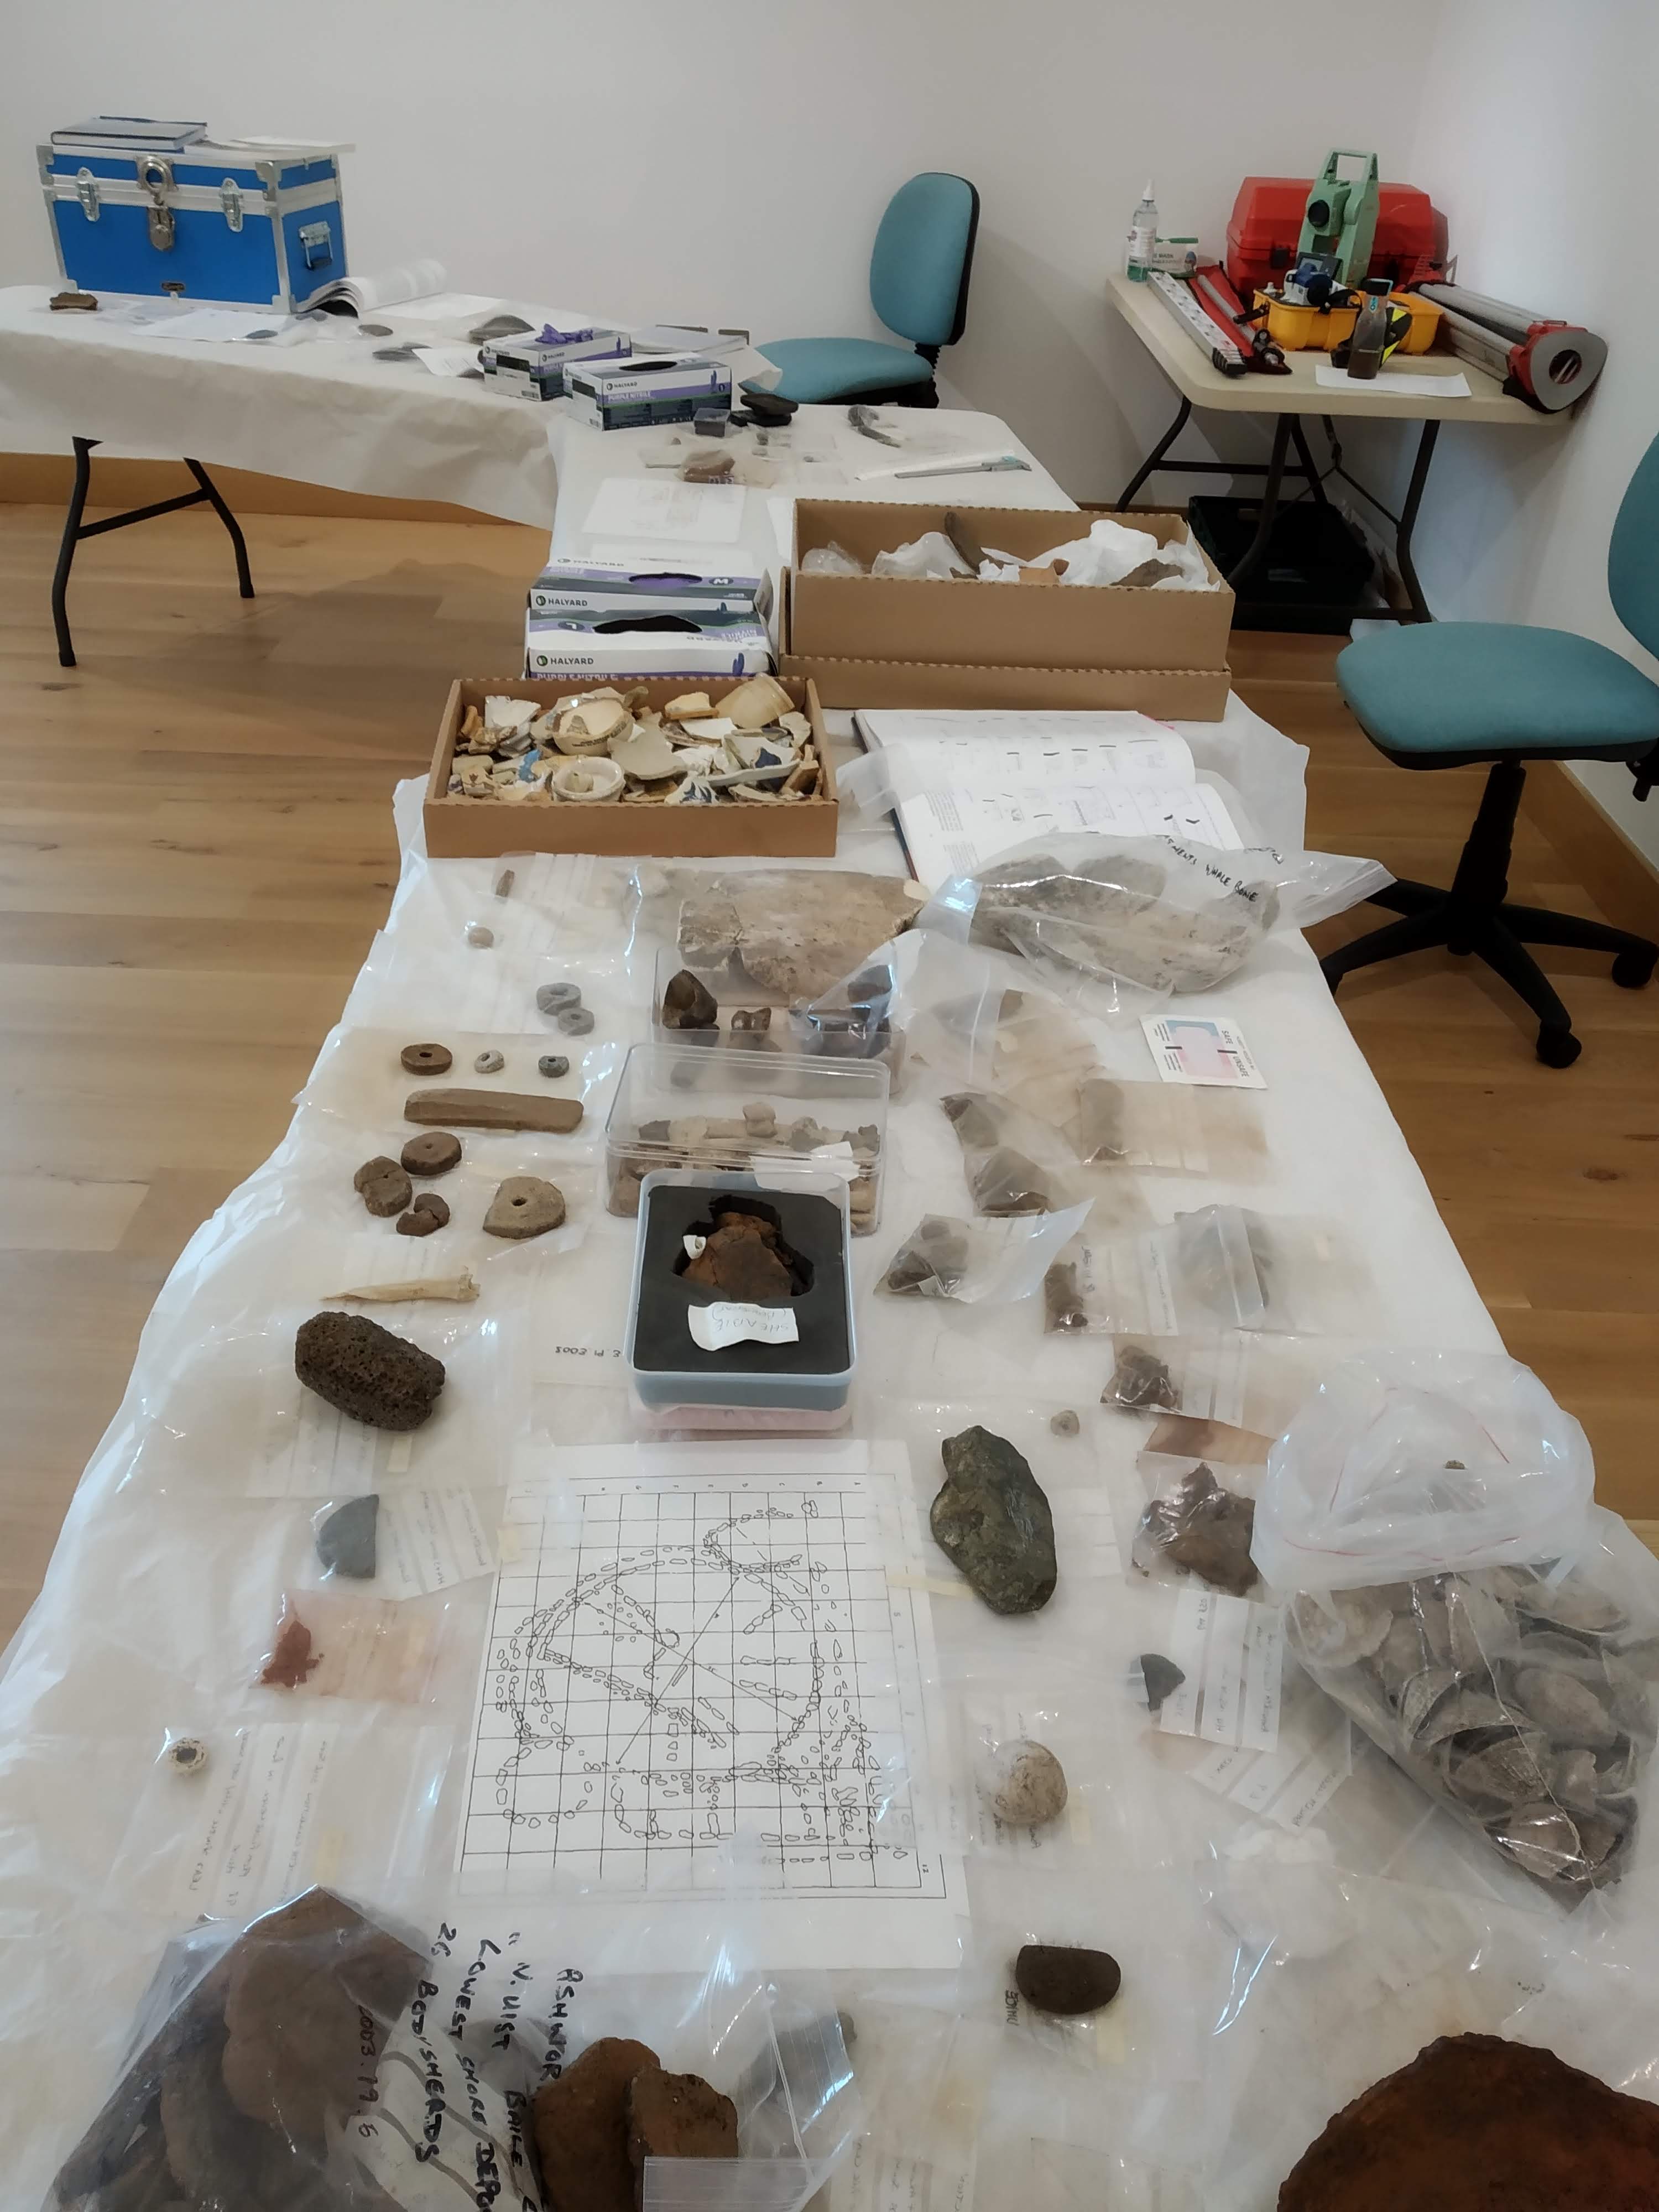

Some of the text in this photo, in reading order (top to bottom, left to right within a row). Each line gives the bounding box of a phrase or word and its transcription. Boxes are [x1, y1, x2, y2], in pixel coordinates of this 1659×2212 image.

[548, 597, 588, 607] HALYARD
[550, 657, 594, 666] HALYARD
[1234, 880, 1259, 902] BONE
[1222, 1030, 1233, 1045] SAFE
[1233, 1056, 1250, 1078] UNSAFE
[492, 1995, 521, 2051] UIST
[540, 1968, 583, 2082] ASHWOR
[448, 1939, 502, 2212] LOWEST SHORE DEPO
